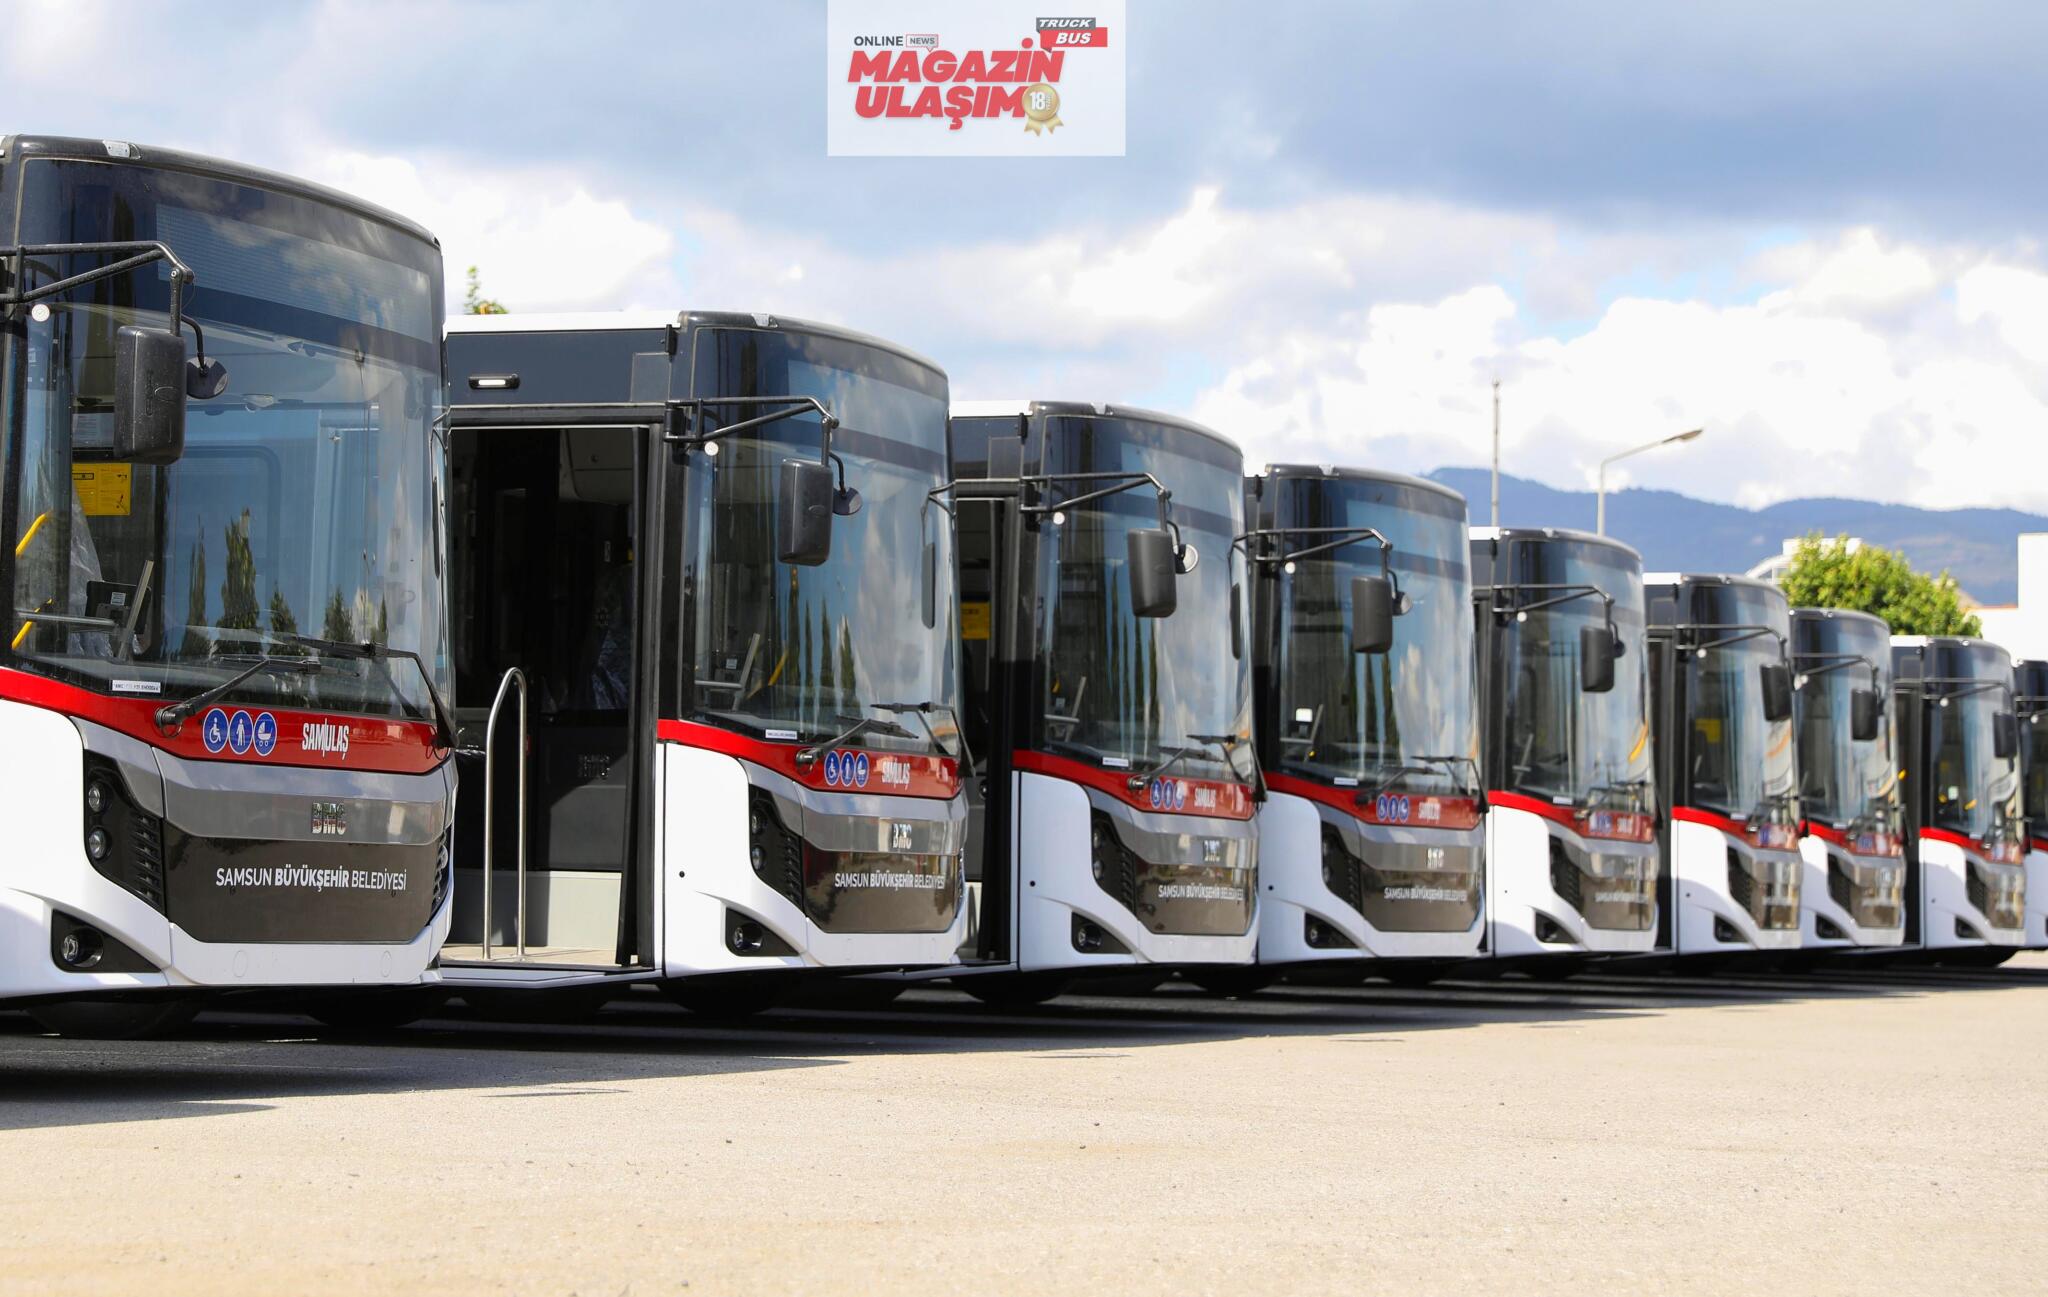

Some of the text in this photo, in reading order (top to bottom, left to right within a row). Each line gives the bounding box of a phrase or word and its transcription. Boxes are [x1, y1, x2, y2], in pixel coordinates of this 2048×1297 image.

[311, 802, 346, 835] BMC
[216, 864, 407, 892] SAMSUN BÜYÜKŞEHİR BELEDİYESİ
[834, 872, 870, 888] SAMSUN
